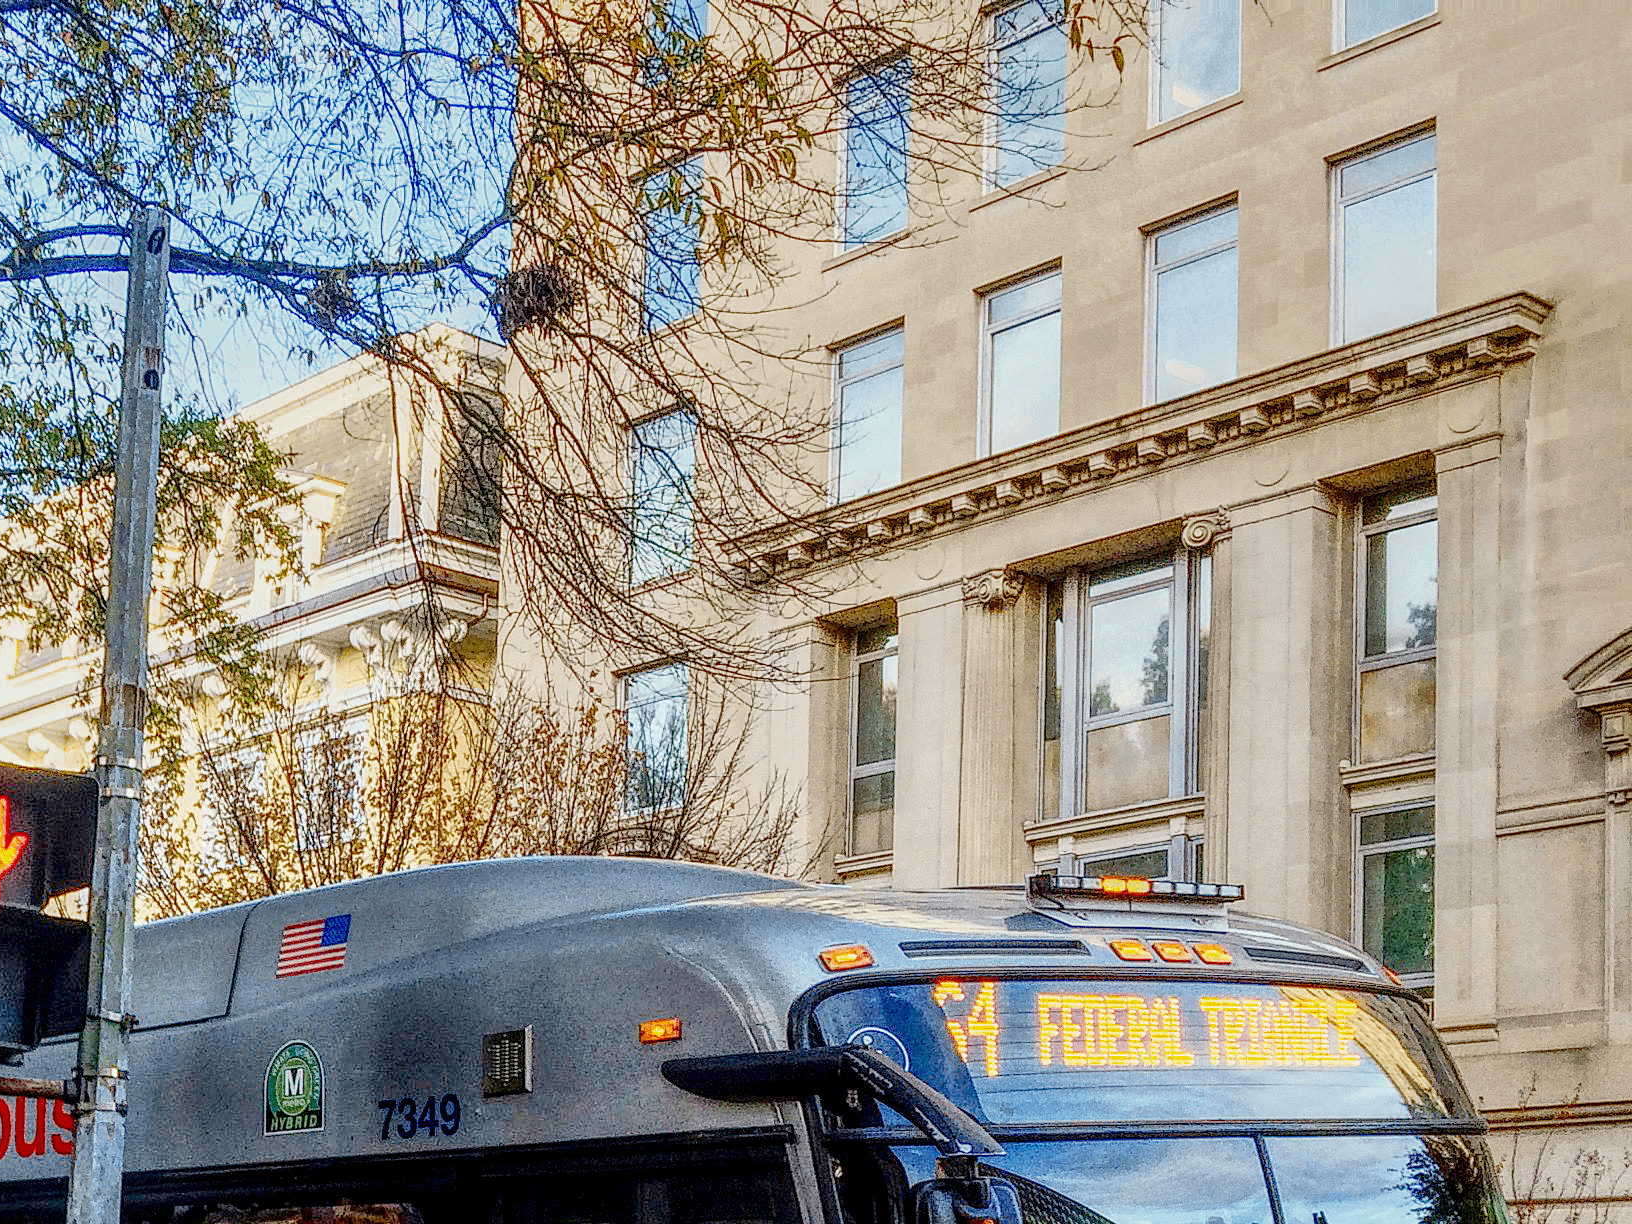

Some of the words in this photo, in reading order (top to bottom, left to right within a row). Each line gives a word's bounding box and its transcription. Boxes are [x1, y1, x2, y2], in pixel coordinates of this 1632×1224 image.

[1037, 993, 1196, 1067] FEDERAL
[1199, 995, 1362, 1067] TRIANGLE
[284, 1067, 305, 1096] M
[270, 1114, 318, 1131] HYBRID
[377, 1093, 462, 1141] 7349
